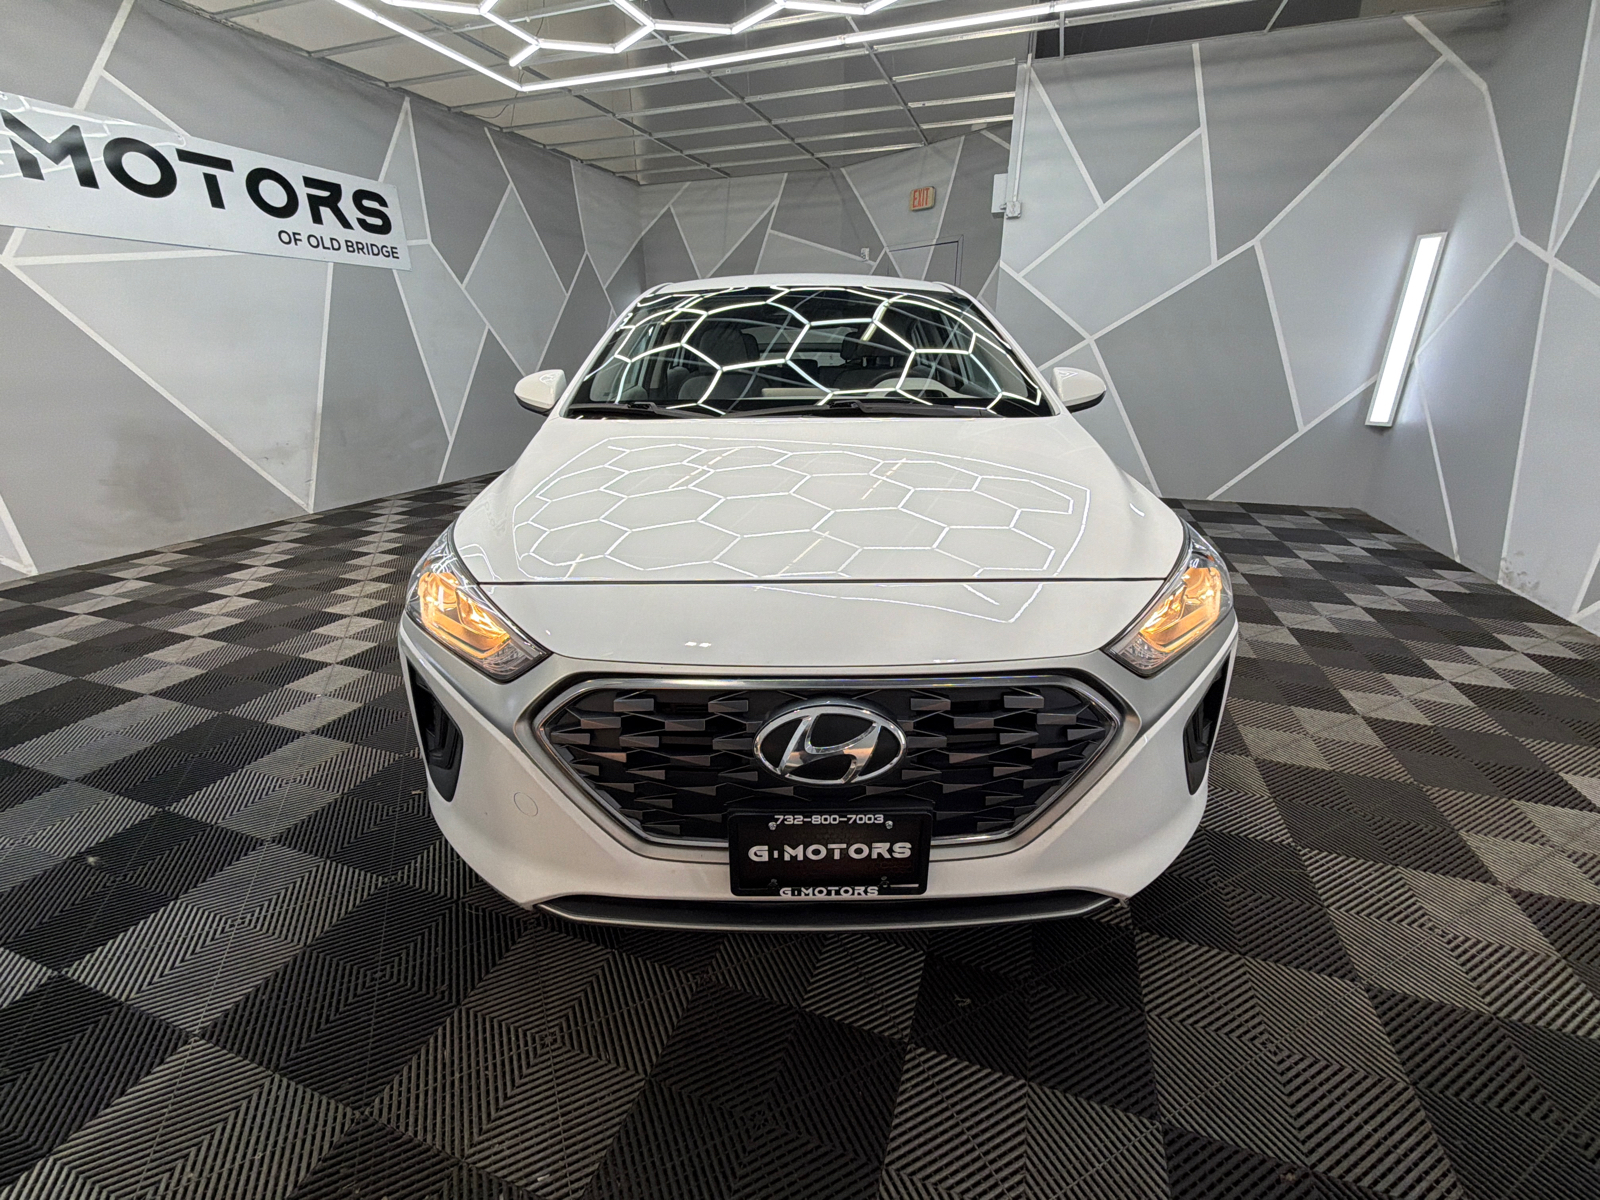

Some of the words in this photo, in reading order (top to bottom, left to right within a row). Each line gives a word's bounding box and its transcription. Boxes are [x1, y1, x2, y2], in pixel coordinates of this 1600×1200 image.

[0, 108, 393, 236] MOTORS
[912, 187, 930, 209] EXIT
[277, 229, 303, 247] OF
[306, 233, 342, 253] OLD
[345, 240, 400, 260] BRIDGE
[774, 814, 884, 825] 732-800-7003
